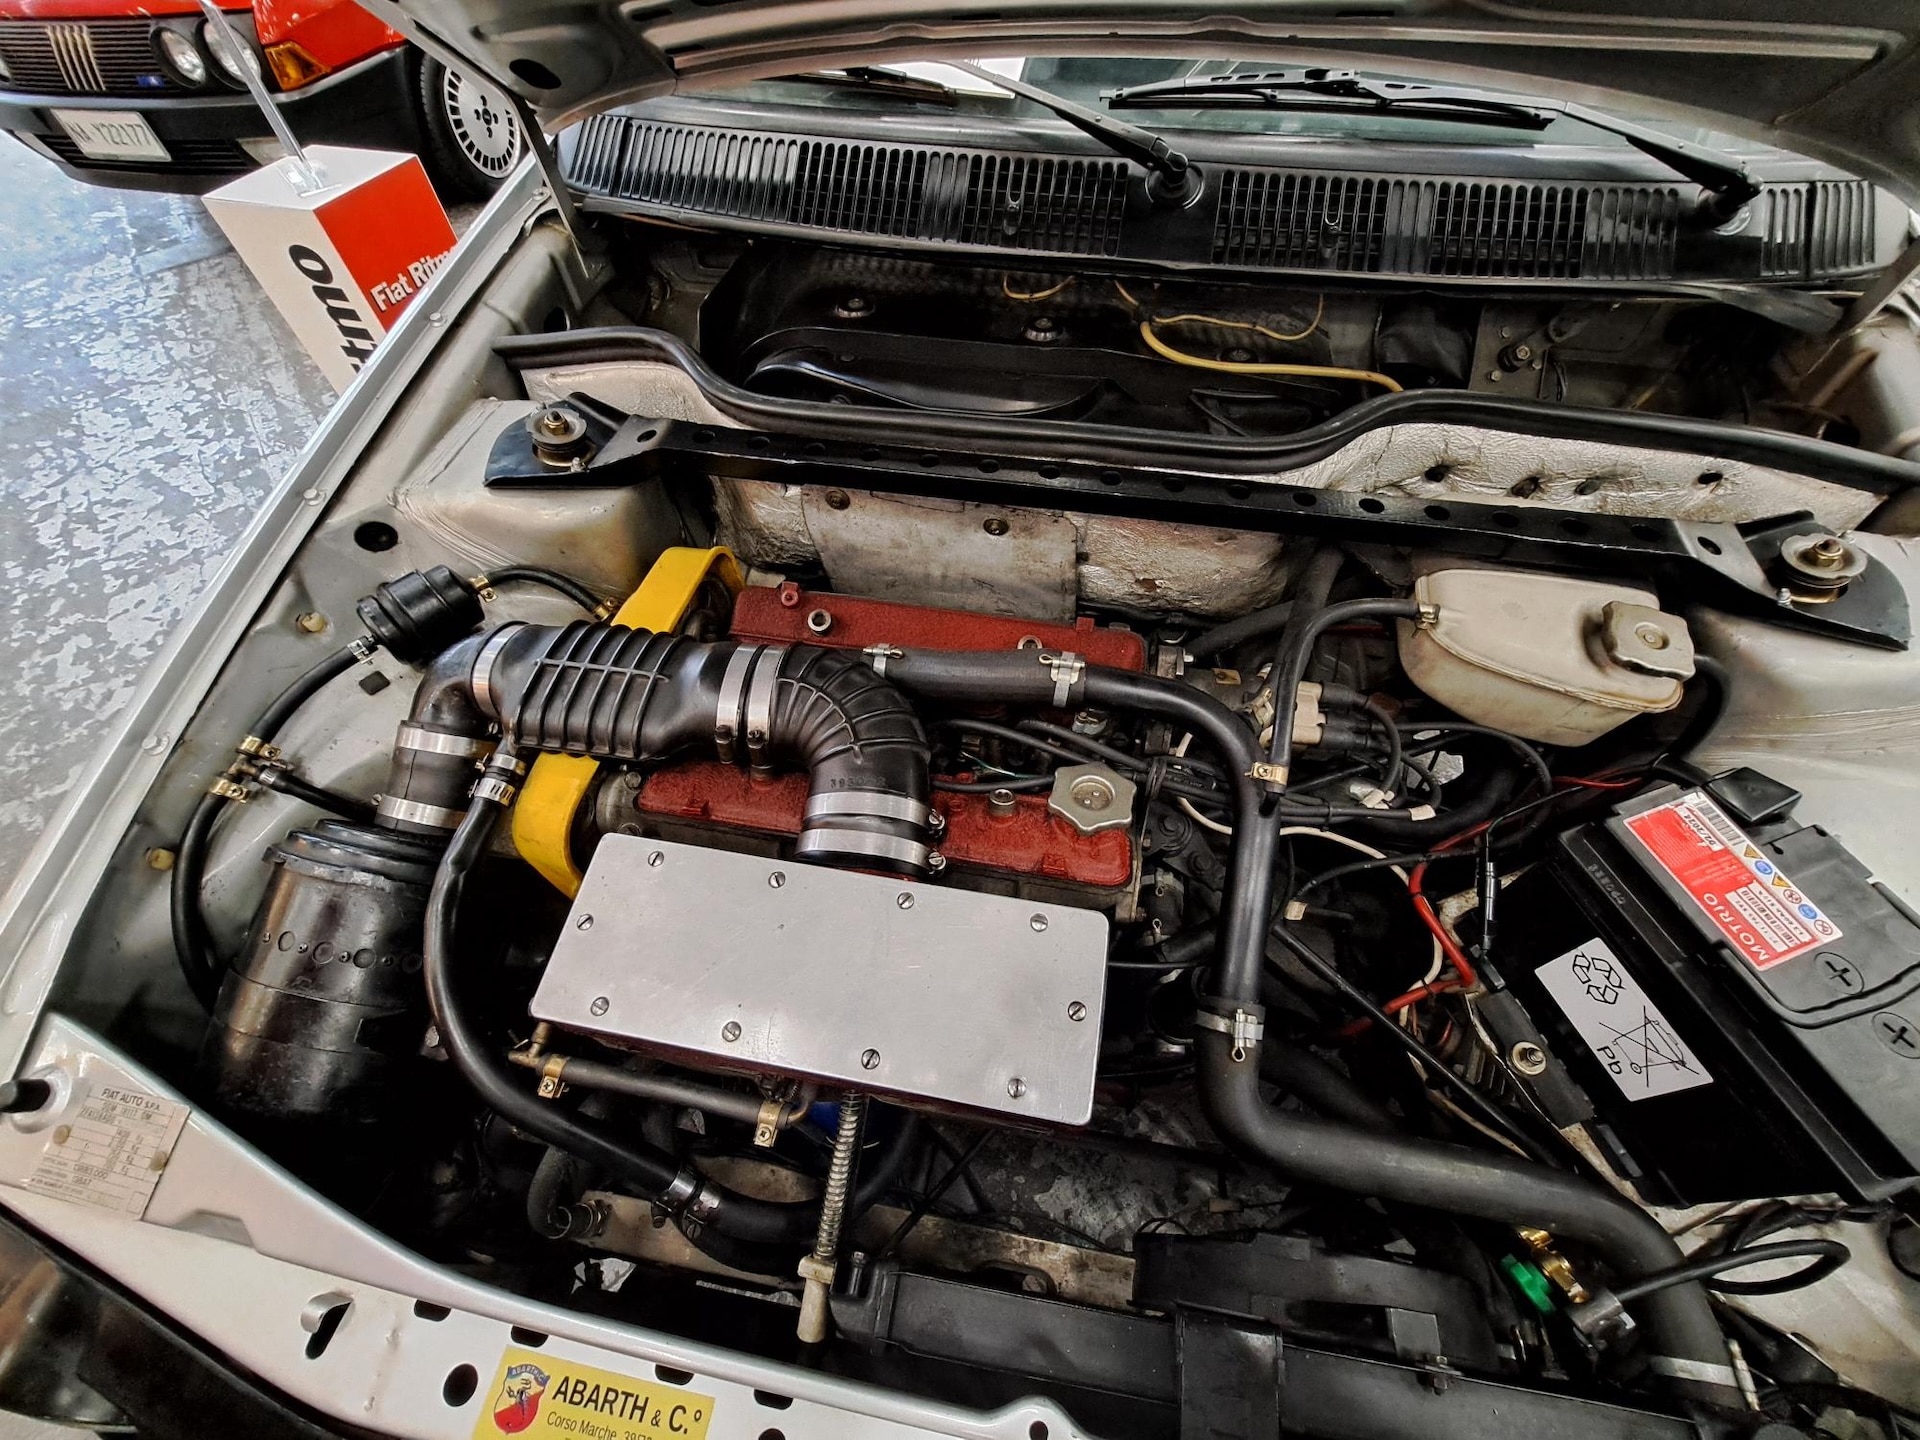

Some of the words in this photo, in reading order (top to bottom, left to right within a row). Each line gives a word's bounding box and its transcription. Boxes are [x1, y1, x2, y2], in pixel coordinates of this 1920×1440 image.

[370, 273, 414, 312] Fiat
[1703, 893, 1770, 960] MOTRIO
[1597, 1046, 1622, 1074] Pb
[119, 1094, 144, 1107] AUTO
[552, 1376, 649, 1423] ABARTH
[650, 1409, 661, 1428] &
[547, 1411, 577, 1432] Corso
[579, 1419, 617, 1440] Marche
